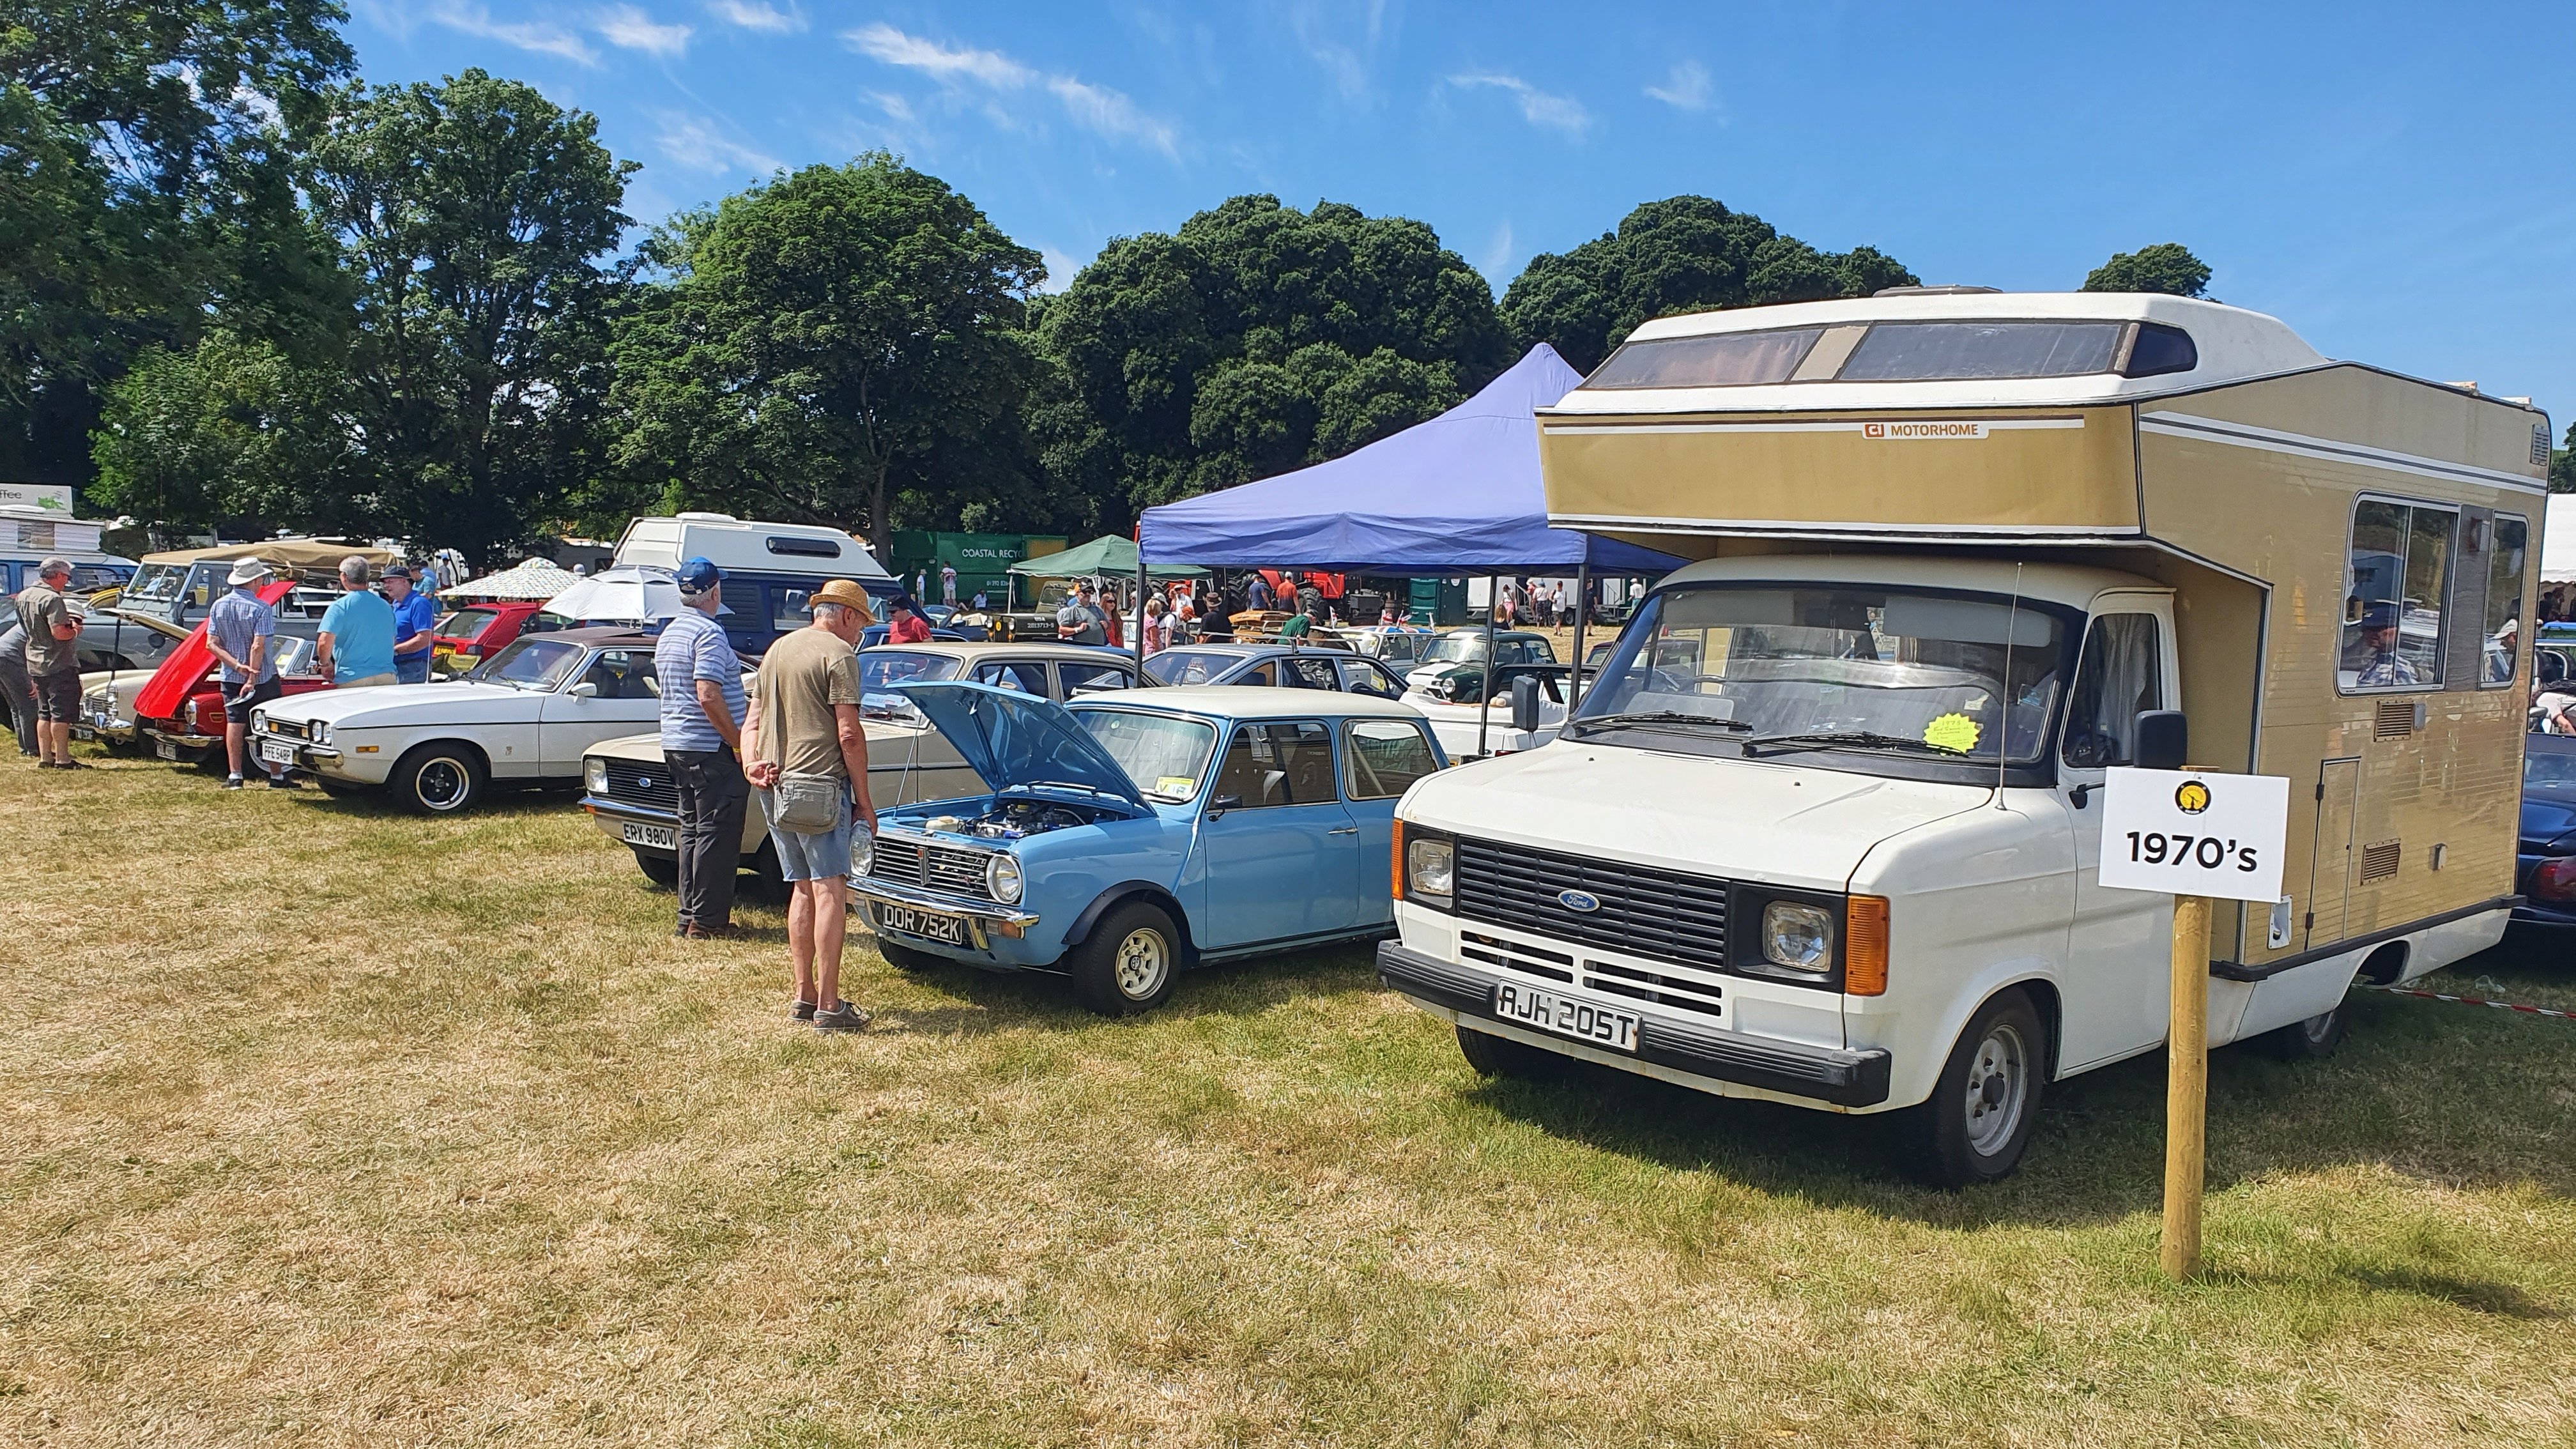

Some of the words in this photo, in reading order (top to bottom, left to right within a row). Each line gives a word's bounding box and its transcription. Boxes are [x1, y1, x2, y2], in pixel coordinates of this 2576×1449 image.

[1891, 424, 1978, 436] MOTORHOME
[962, 549, 997, 557] COASTAL
[264, 746, 275, 758] PFE
[624, 824, 644, 842] ERX
[645, 827, 673, 847] 980V
[2127, 831, 2257, 872] 1970's
[1567, 894, 1589, 908] Ford
[884, 904, 914, 931] DOR
[919, 912, 960, 941] 752K
[1499, 985, 1552, 1025] AJH
[1557, 999, 1634, 1045] 205T
